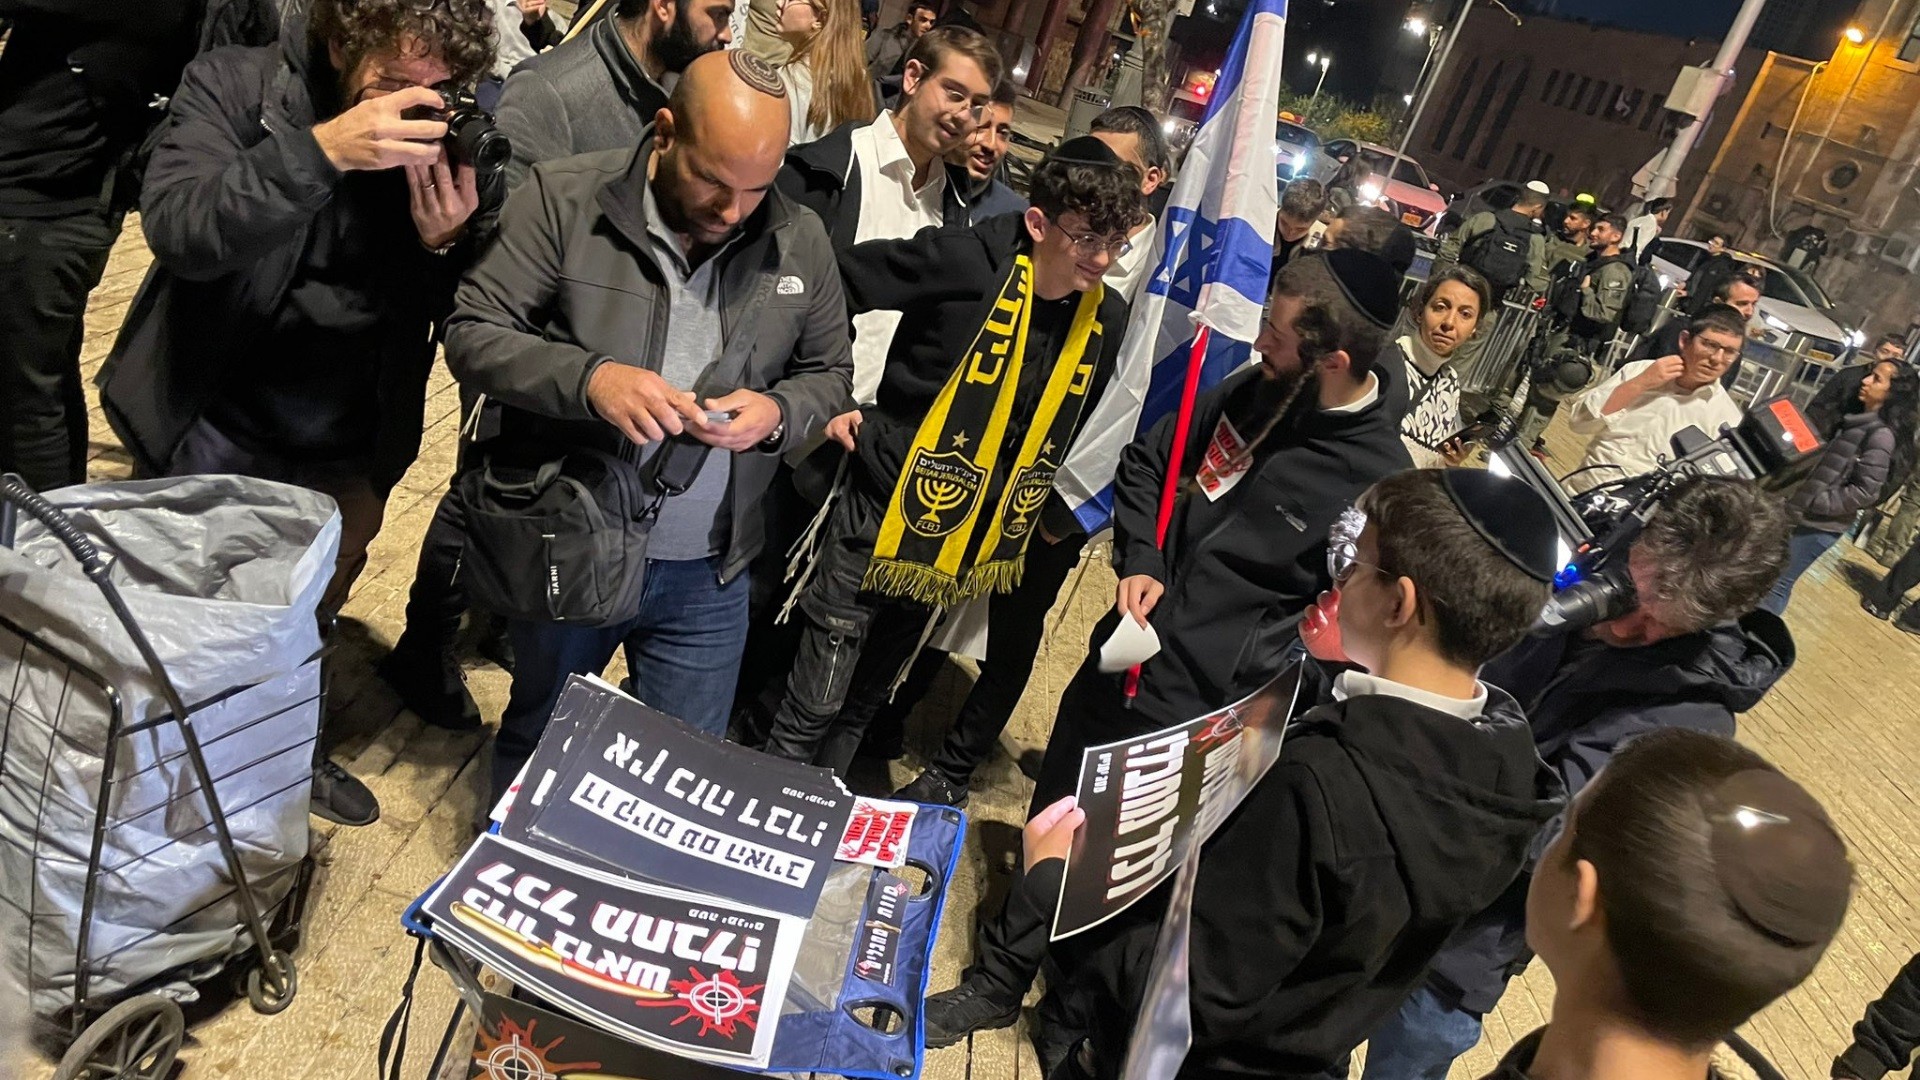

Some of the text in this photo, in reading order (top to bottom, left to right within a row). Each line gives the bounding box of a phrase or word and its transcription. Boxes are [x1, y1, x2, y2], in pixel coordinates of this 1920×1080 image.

[939, 472, 977, 491] JERUSALEM
[915, 519, 941, 533] FCBJ
[602, 731, 669, 785] אין
[665, 767, 736, 818] כזה
[735, 796, 828, 848] דבר!
[583, 781, 806, 883] דו קיום עם האויב
[843, 815, 869, 844] אסור
[859, 812, 891, 855] לשחרר
[876, 811, 913, 862] מחבלים
[1106, 815, 1180, 900] לכל
[476, 862, 762, 974] לכל מחבל!
[550, 931, 671, 992] בראש
